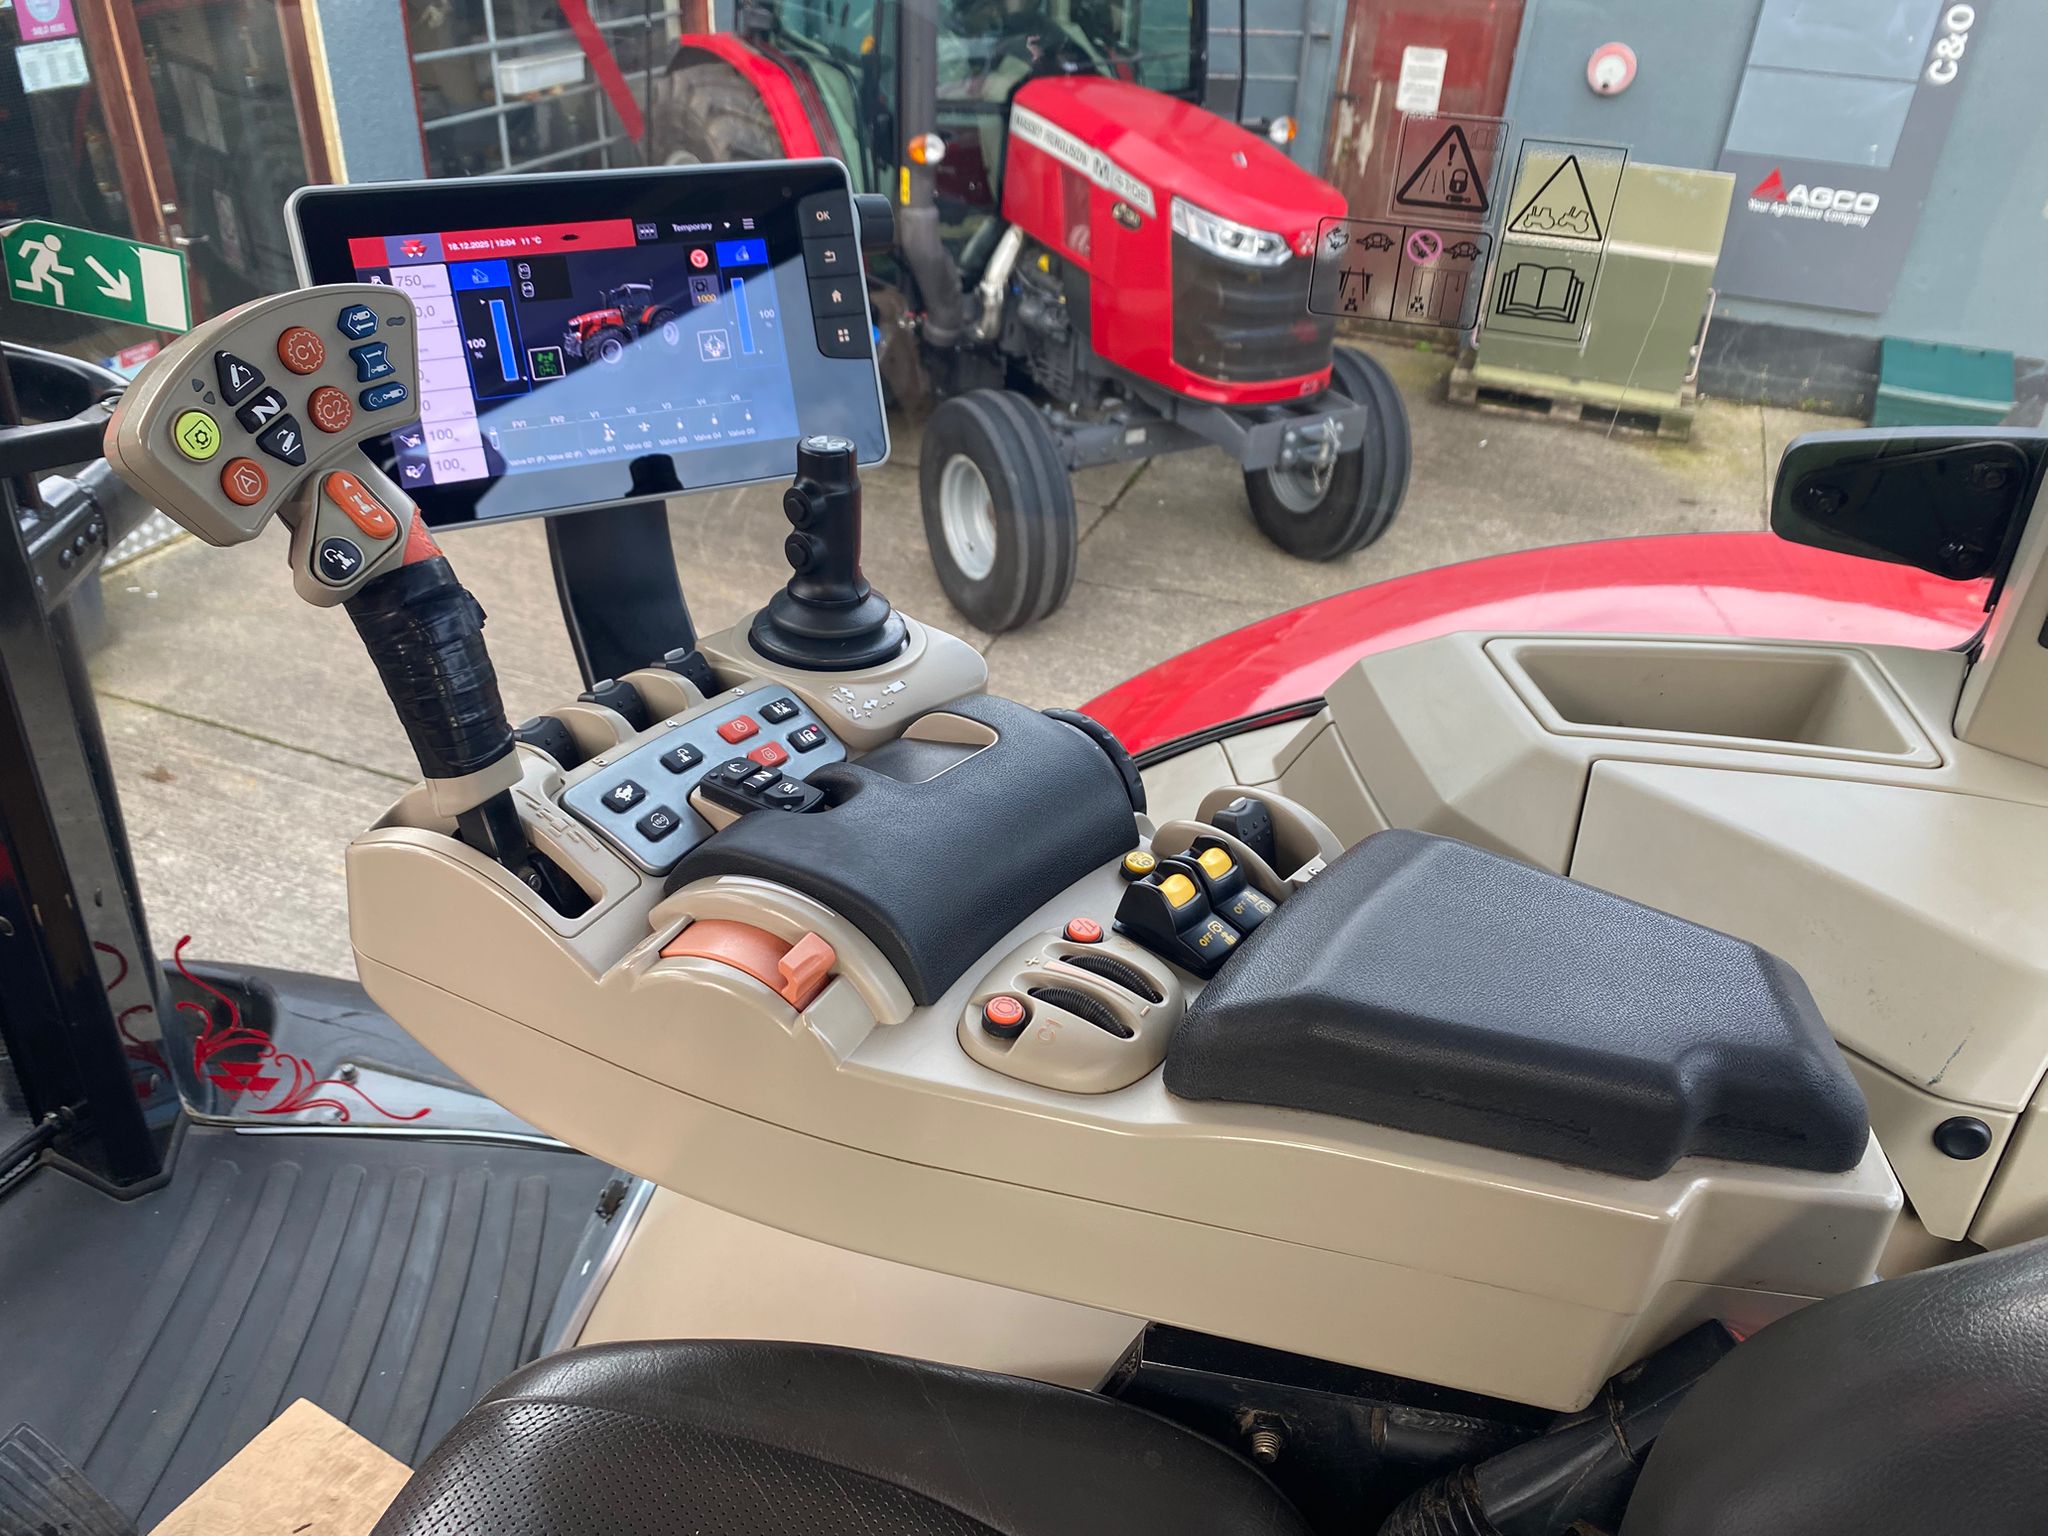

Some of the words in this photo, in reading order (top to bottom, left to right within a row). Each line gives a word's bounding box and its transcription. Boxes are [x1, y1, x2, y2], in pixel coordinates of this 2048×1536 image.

[1929, 3, 1975, 85] C&O
[1786, 184, 1880, 215] AGCO
[815, 210, 831, 221] OK
[1747, 198, 1771, 214] Your
[1769, 201, 1824, 221] Agriculture
[1823, 208, 1871, 228] Company
[671, 221, 713, 233] Temporary
[395, 274, 422, 288] 750
[697, 293, 717, 304] 1000
[758, 308, 775, 319] 100
[295, 340, 318, 361] C1
[466, 338, 487, 350] 100
[251, 395, 281, 425] N
[322, 399, 346, 420] C2
[428, 428, 454, 441] 100
[434, 457, 460, 472] 100
[240, 474, 257, 493] A
[752, 770, 773, 782] N
[1233, 900, 1248, 915] OFF
[1198, 931, 1214, 947] OFF
